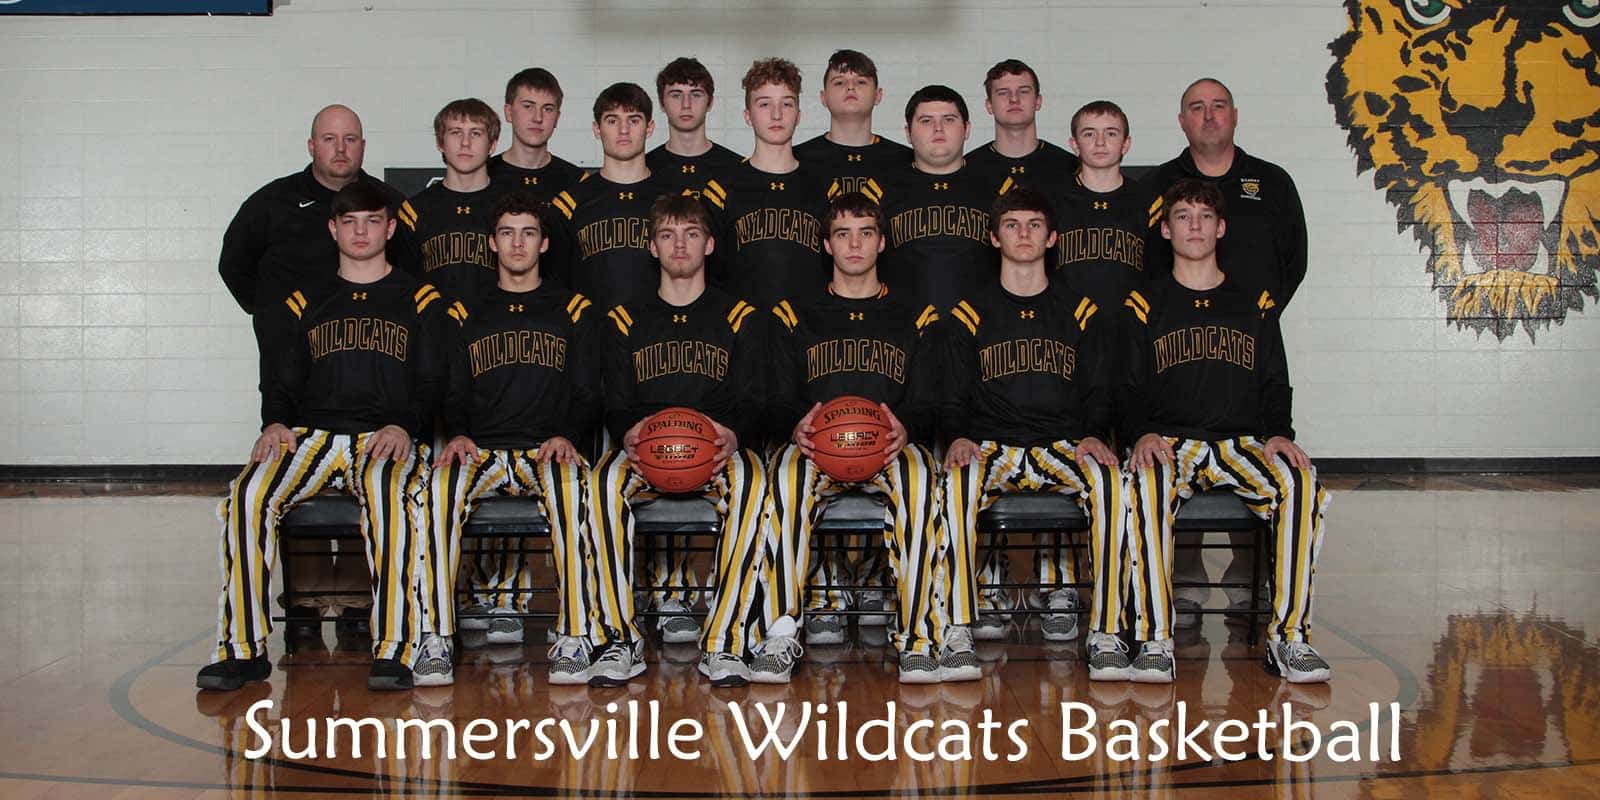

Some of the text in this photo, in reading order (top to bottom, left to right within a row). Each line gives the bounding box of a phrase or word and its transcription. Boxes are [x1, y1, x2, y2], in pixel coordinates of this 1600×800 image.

[577, 217, 650, 258] WILDCA
[736, 208, 822, 253] WILDCATS
[890, 206, 992, 248] WILDCATS
[421, 231, 497, 272] WILDCA
[308, 318, 408, 363] WILDCATS
[468, 331, 567, 377] WILDCATS
[632, 340, 730, 384] WILDCATS
[806, 338, 905, 384] WILDCATS
[979, 339, 1076, 384] WILDCATS
[1154, 327, 1255, 374] WILDCATS
[647, 420, 703, 435] SPALDING
[824, 407, 881, 424] SPALDING
